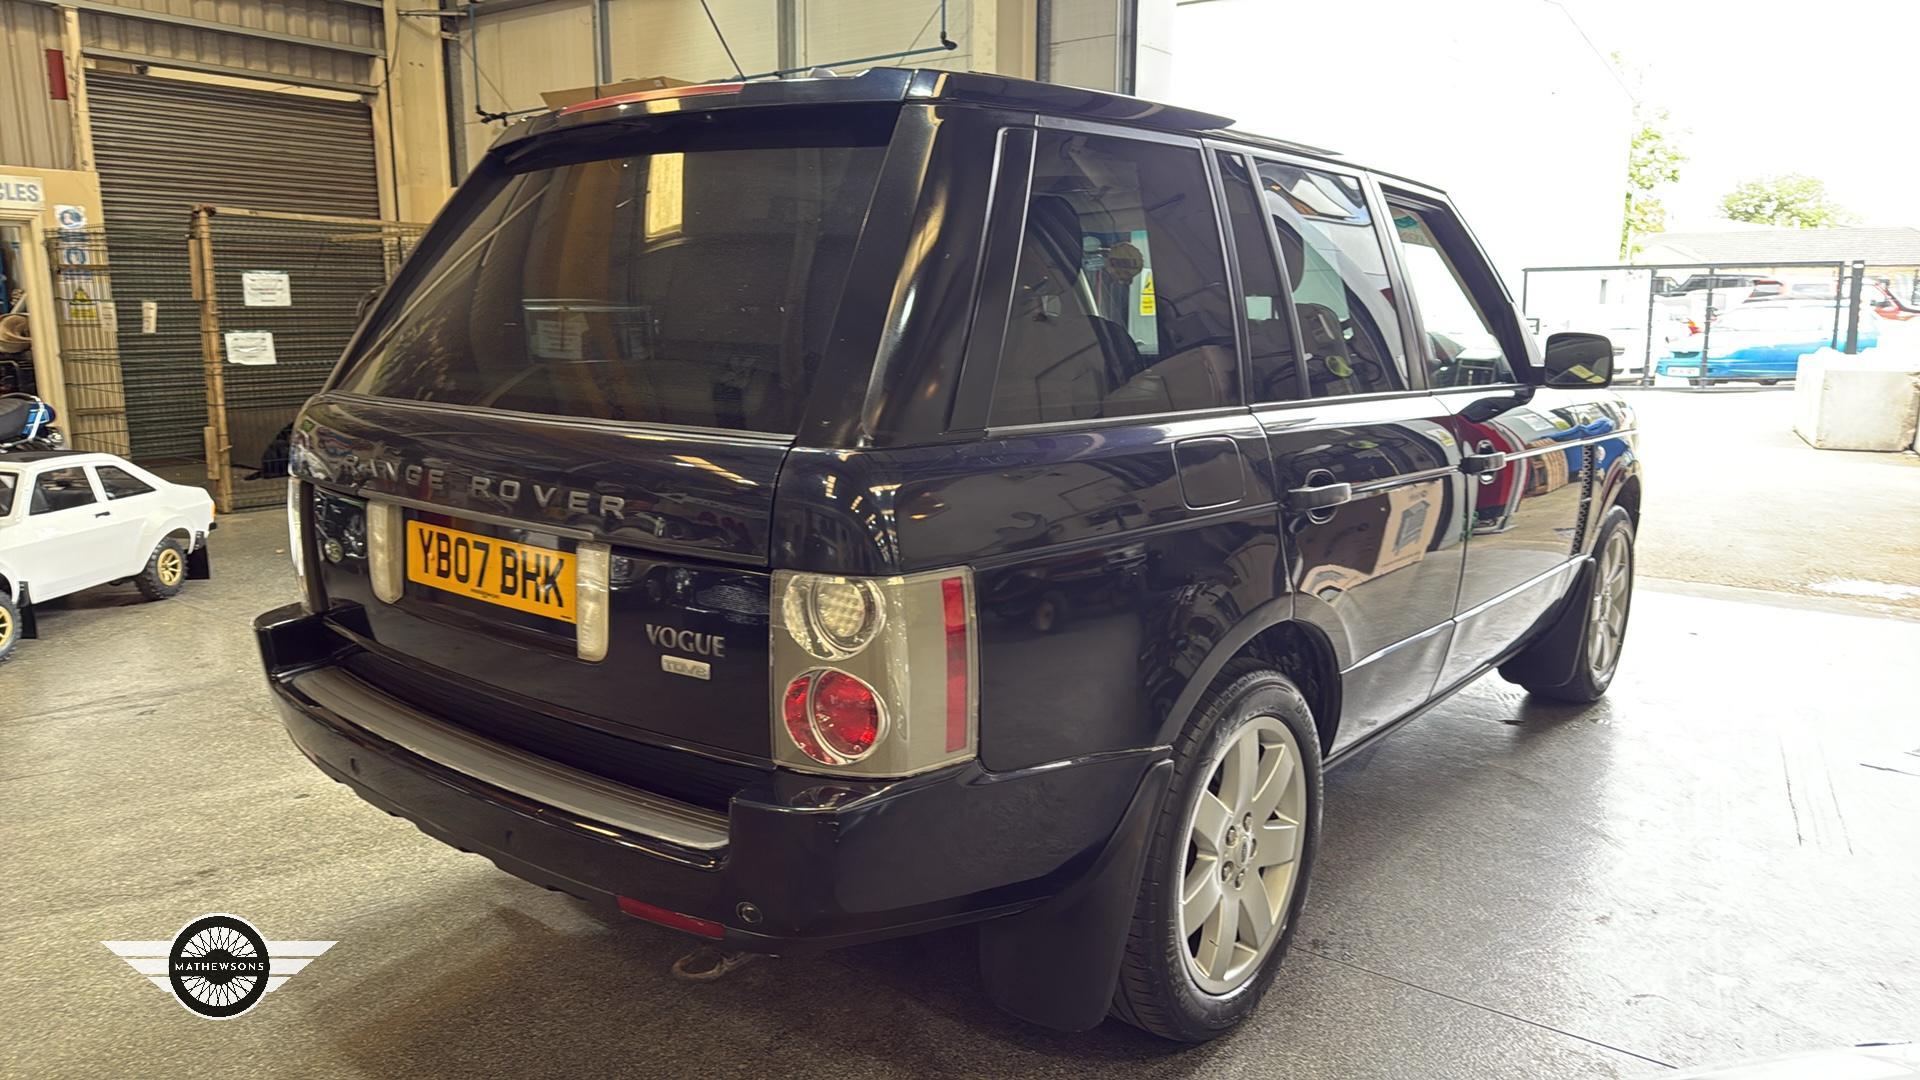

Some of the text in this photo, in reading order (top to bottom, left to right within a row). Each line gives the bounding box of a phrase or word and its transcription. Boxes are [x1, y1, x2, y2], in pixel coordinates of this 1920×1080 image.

[341, 454, 625, 521] RANGE ROVER
[418, 527, 565, 608] YB07 BHK
[645, 623, 726, 658] VOGUE
